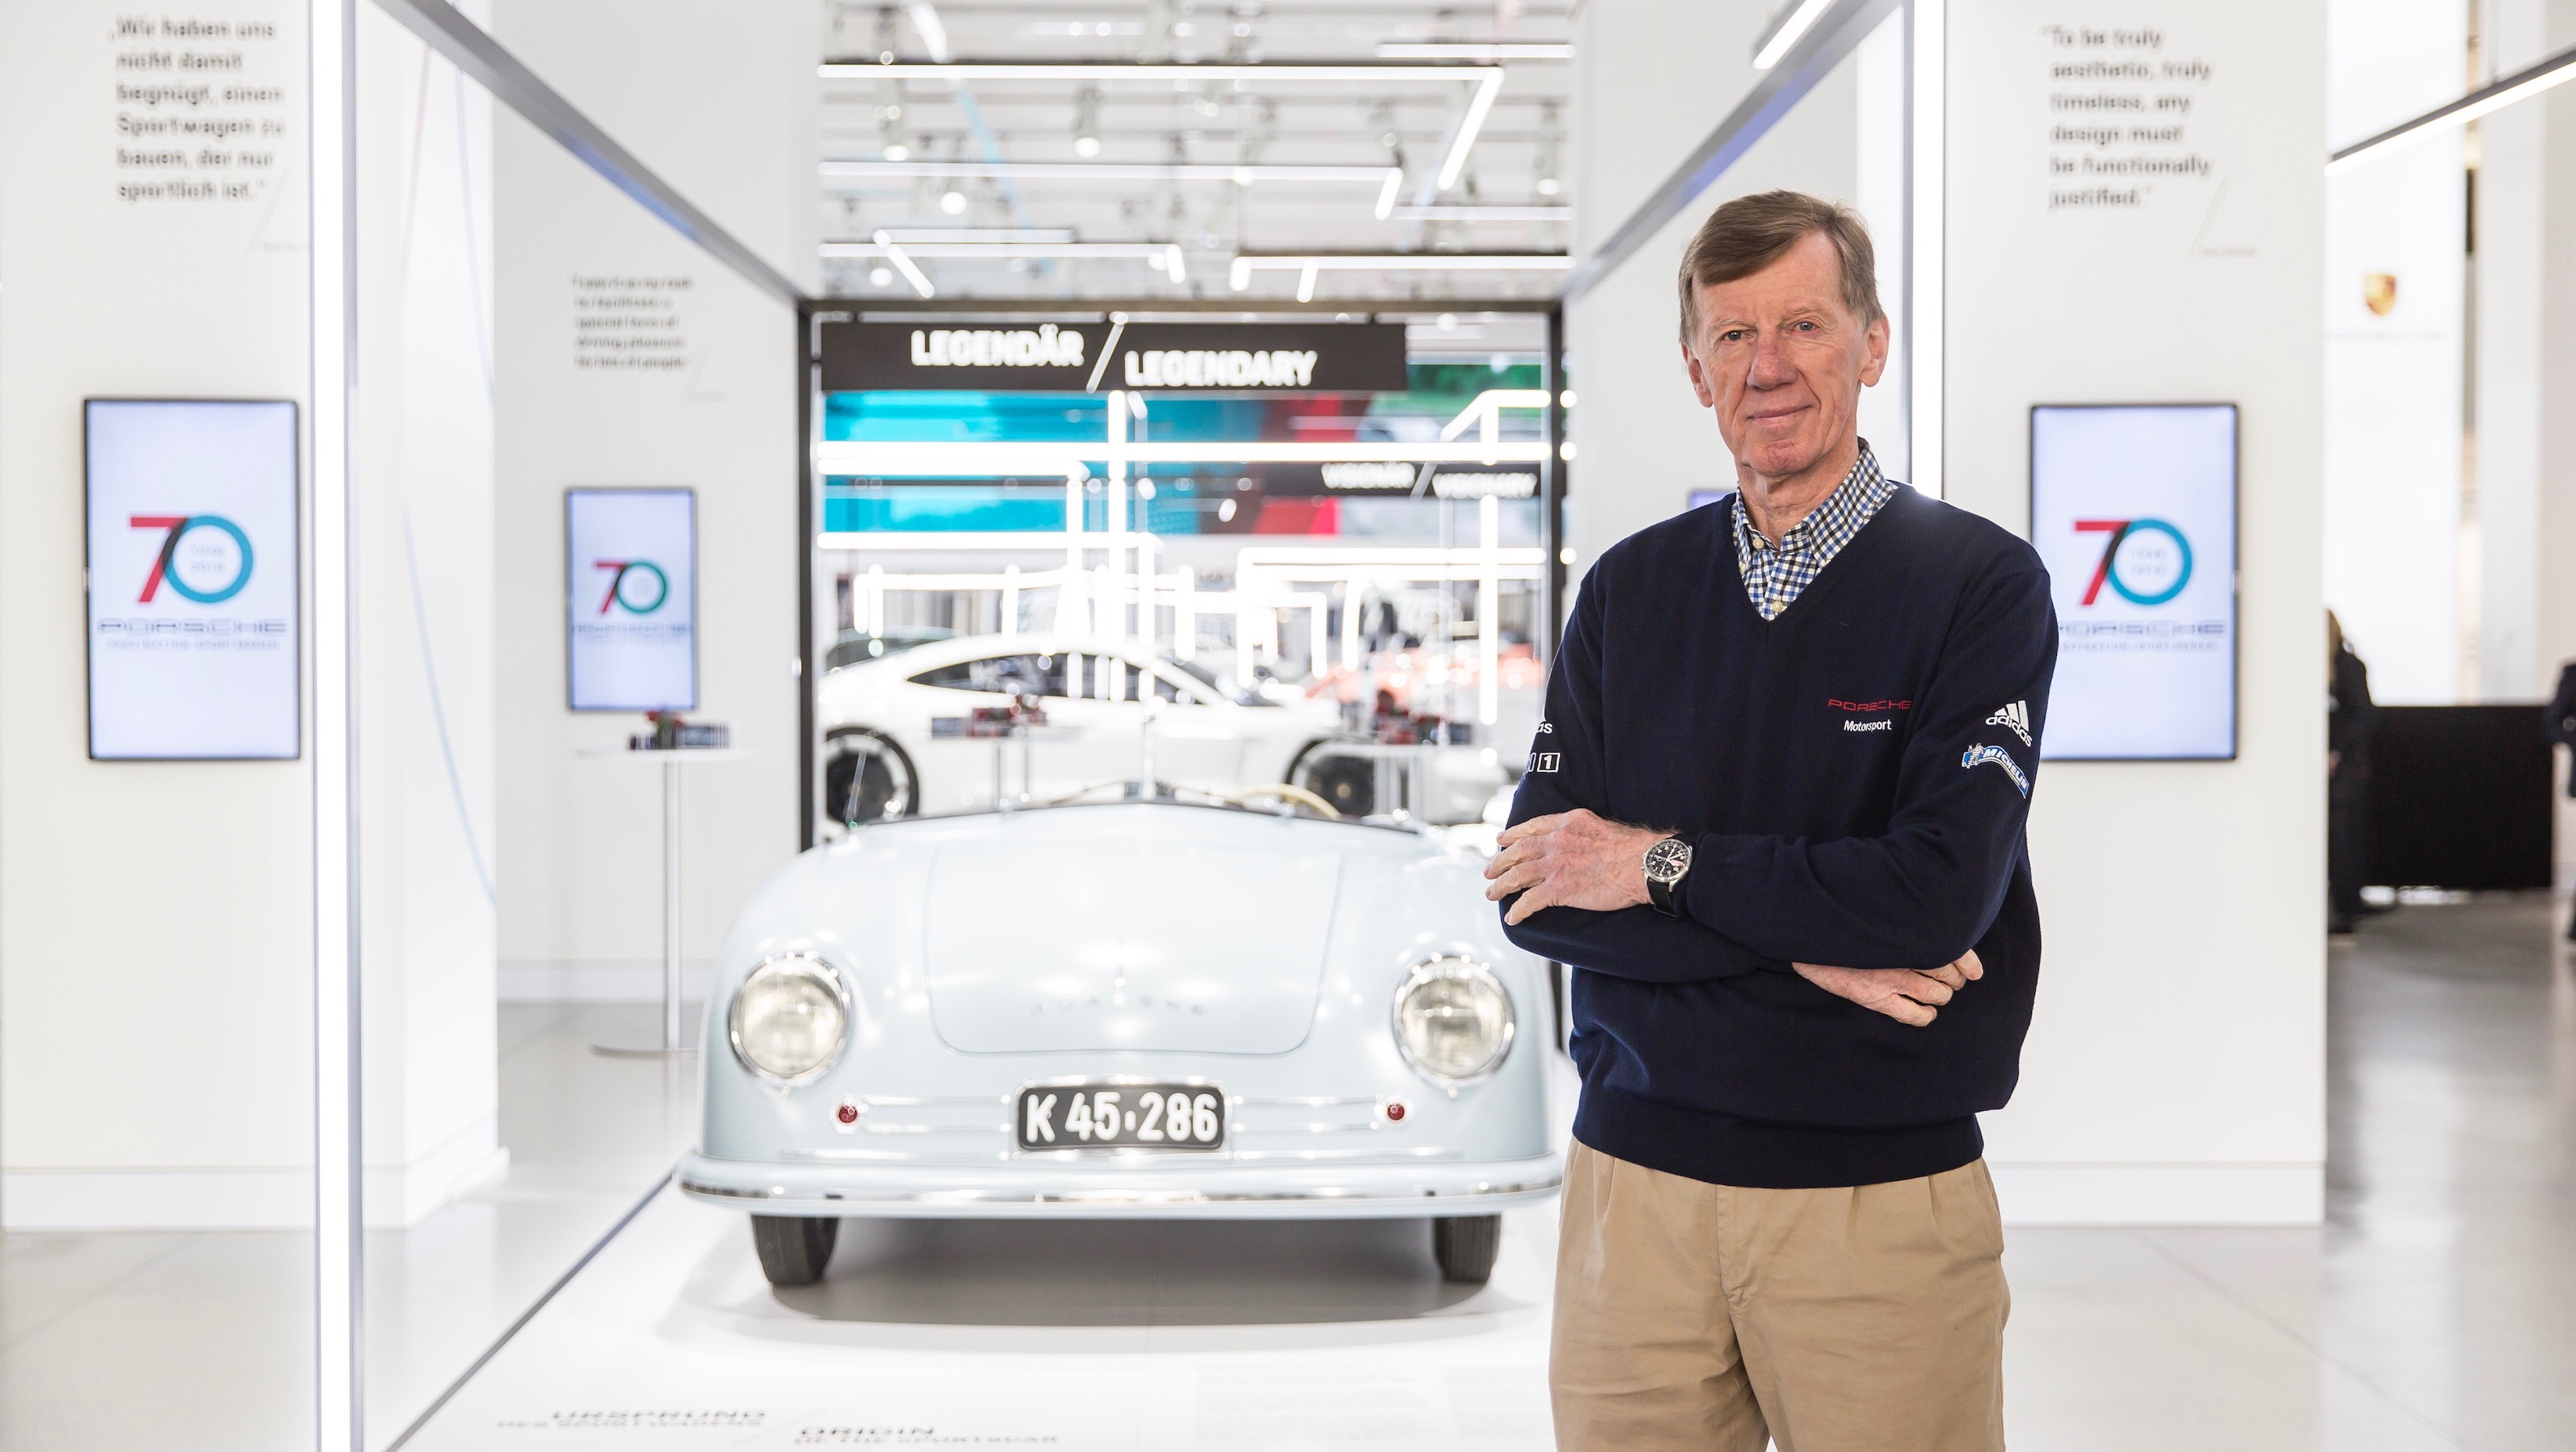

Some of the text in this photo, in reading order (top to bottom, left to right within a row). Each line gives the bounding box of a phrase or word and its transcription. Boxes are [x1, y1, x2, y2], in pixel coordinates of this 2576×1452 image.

[911, 324, 1085, 366] LEGENDÄR
[1124, 350, 1318, 386] LEGENDARY
[130, 515, 254, 604] 70
[2075, 519, 2193, 606] 70
[596, 561, 668, 614] 70
[98, 618, 286, 636] PORSCHE
[1828, 699, 1912, 712] PORSCHE
[1844, 719, 1892, 732] Motorsport
[1985, 715, 2033, 747] adidas
[1983, 749, 2028, 789] MICHELIN
[1026, 1093, 1058, 1143] K
